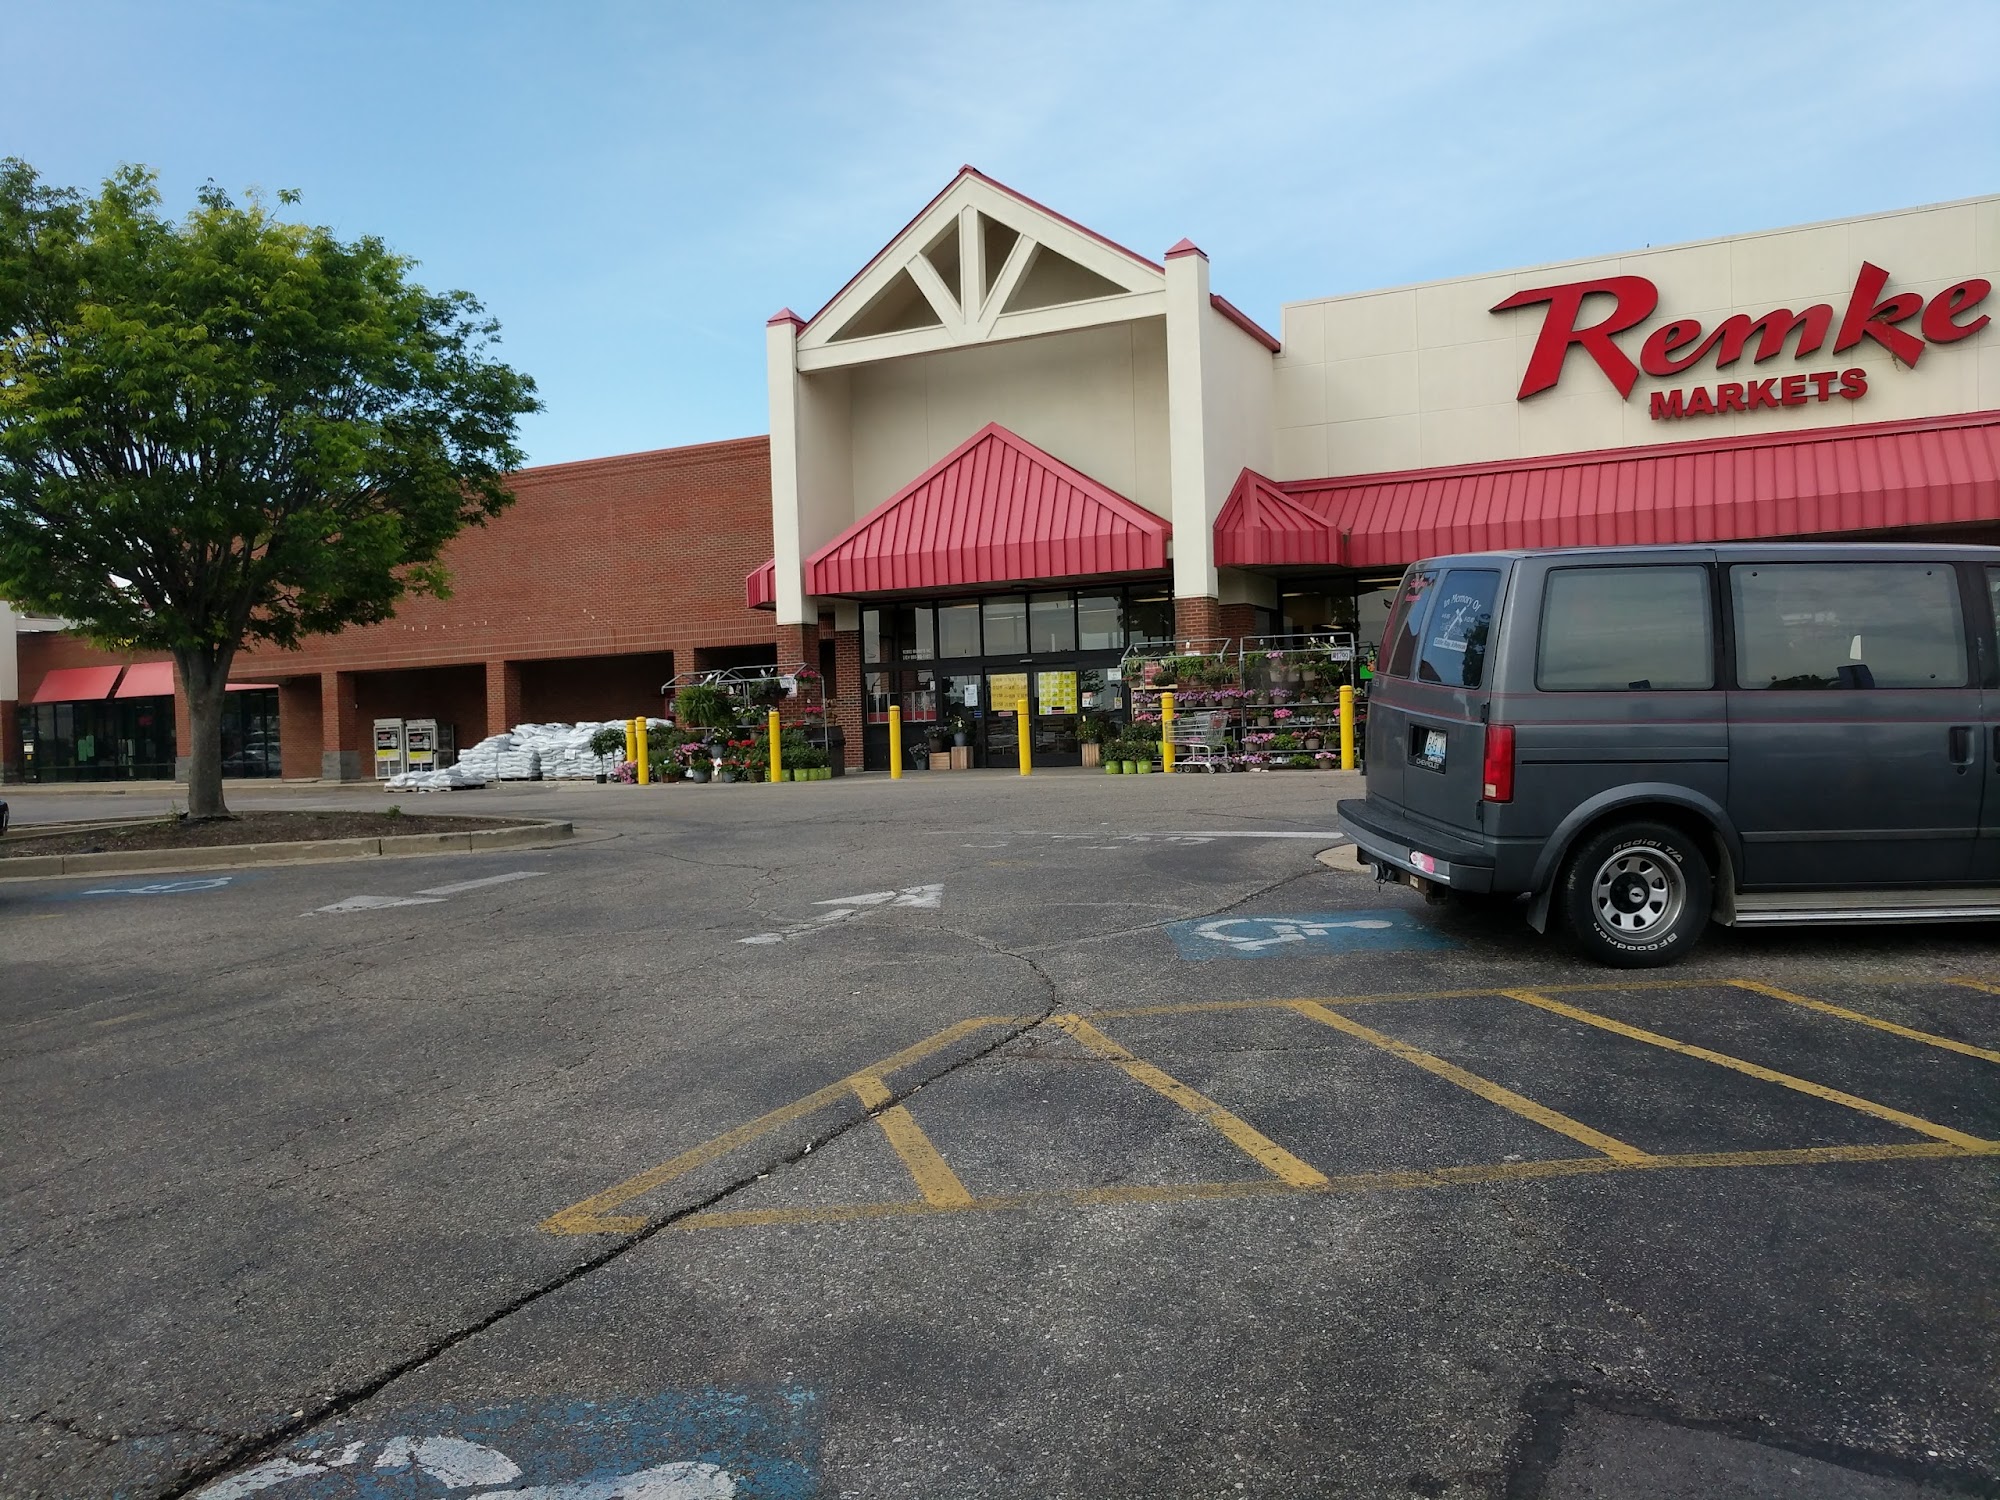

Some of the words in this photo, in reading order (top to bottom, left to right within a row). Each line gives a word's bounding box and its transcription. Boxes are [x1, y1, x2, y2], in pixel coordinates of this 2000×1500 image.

[1488, 260, 1992, 401] Remke
[1649, 368, 1868, 421] MARKETS
[1451, 593, 1474, 608] Memory
[1612, 839, 1662, 854] Radial
[1665, 845, 1684, 863] T/A
[1593, 922, 1678, 951] BFGoodrich
